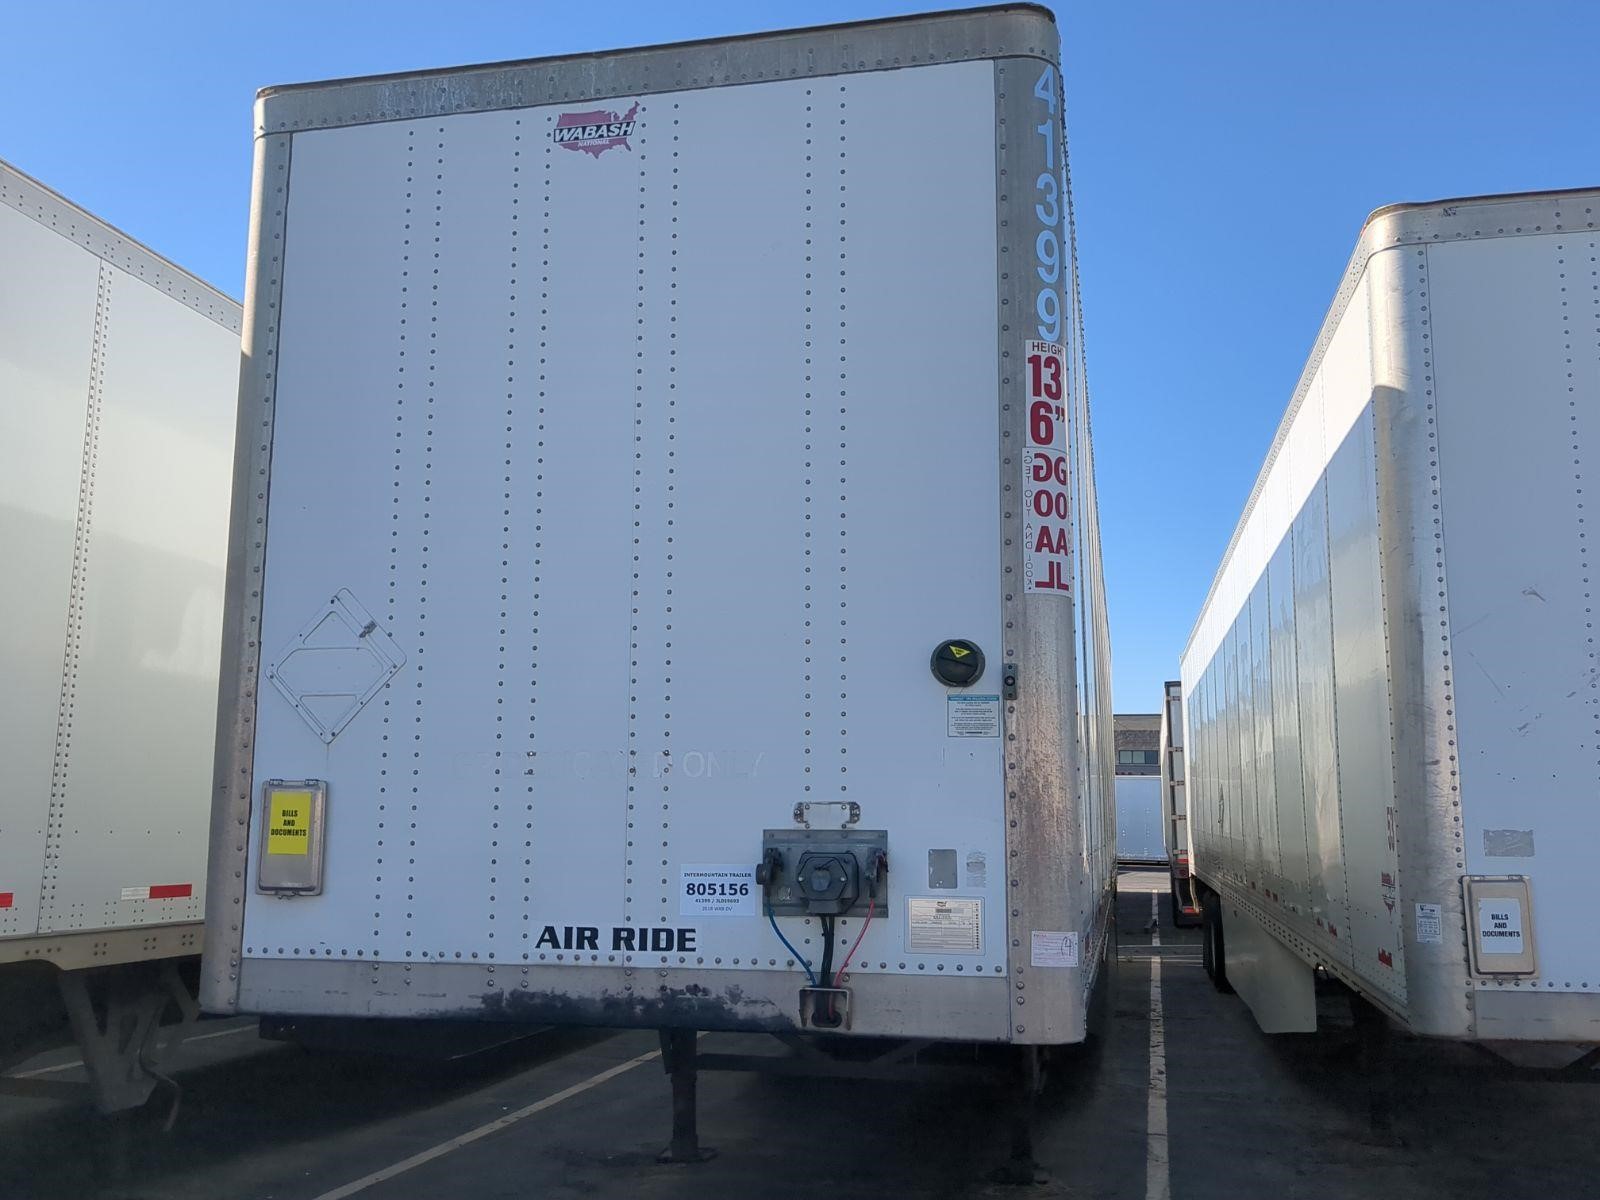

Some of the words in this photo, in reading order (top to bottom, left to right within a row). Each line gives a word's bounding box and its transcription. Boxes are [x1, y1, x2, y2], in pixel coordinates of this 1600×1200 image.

[554, 122, 635, 142] WABASH
[1034, 64, 1060, 341] 41399
[1032, 341, 1064, 355] HEIGH
[271, 829, 307, 837] DOCUMENTS
[686, 883, 749, 896] 805156
[1491, 913, 1509, 921] BILLS
[535, 926, 600, 950] AIR
[612, 927, 697, 952] RIDE
